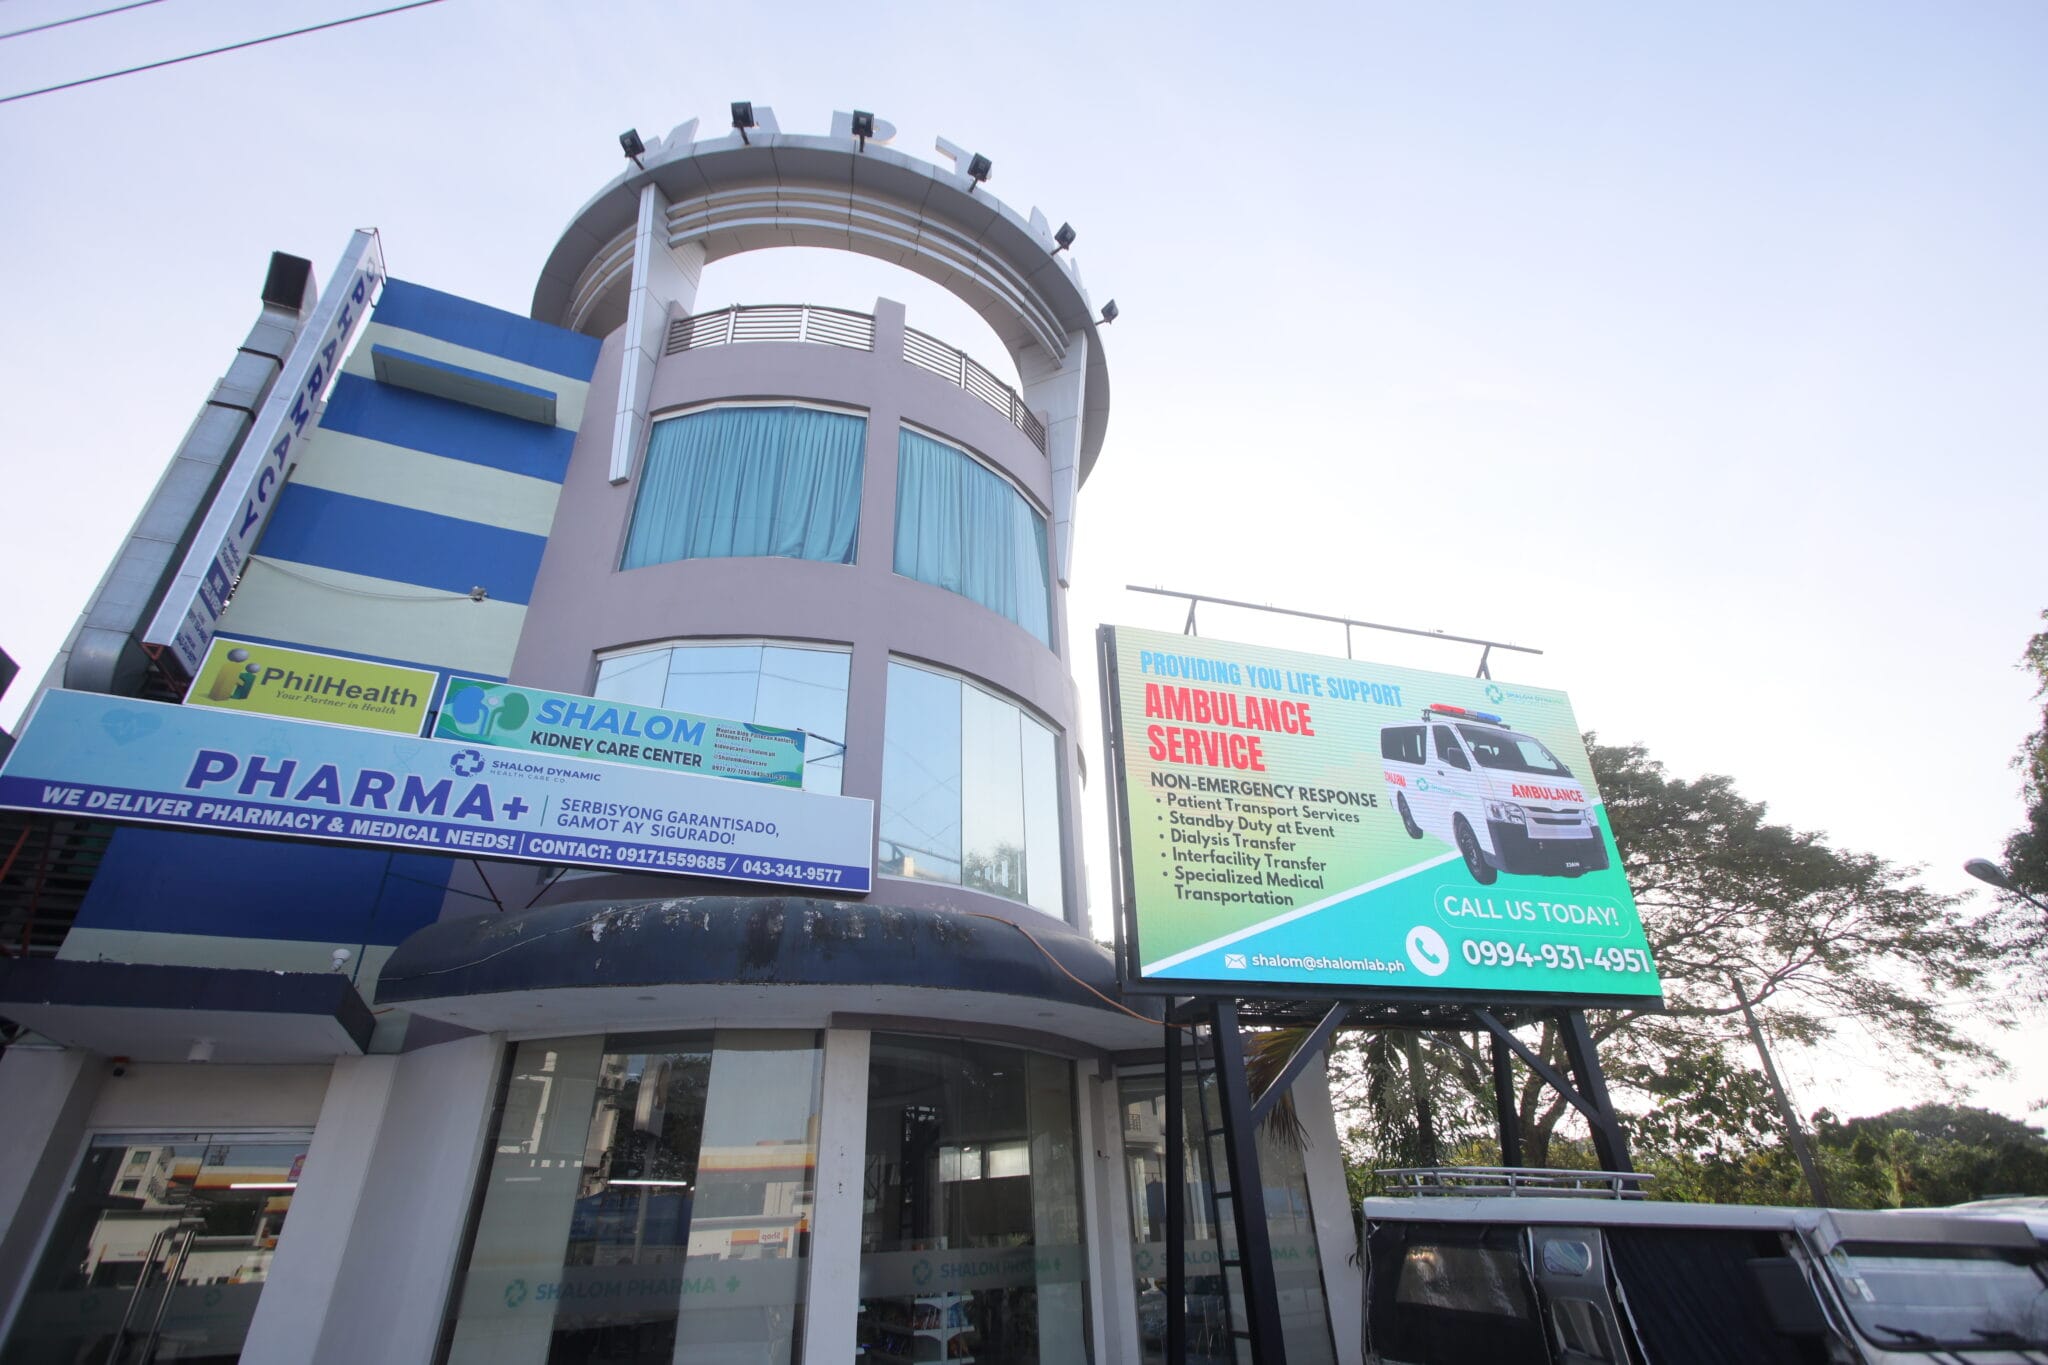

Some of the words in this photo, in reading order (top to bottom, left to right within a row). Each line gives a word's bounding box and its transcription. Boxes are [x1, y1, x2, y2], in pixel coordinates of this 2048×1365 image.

[239, 275, 366, 538] PHARMACY
[260, 667, 418, 708] PhilHealth
[1140, 650, 1242, 687] PROVIDING
[1245, 666, 1282, 692] YOU
[1288, 671, 1324, 697] LIFE
[1327, 678, 1402, 707] SUPPORT
[276, 690, 301, 702] Your
[303, 694, 346, 709] Partner
[348, 700, 359, 710] in
[361, 703, 397, 716] Health
[1145, 682, 1315, 737] AMBULANCE
[535, 699, 707, 746] SHALOM
[530, 730, 594, 753] KIDNEY
[595, 740, 639, 759] CARE
[641, 746, 703, 769] CENTER
[1147, 724, 1266, 772] SERVICE
[490, 769, 524, 778] HEALTH
[528, 774, 550, 782] CARE
[492, 760, 544, 774] SHALOM
[547, 767, 602, 782] DYNAMIC
[1151, 771, 1296, 800] NON-EMERGENCY
[1299, 786, 1378, 808] RESPONSE
[1511, 784, 1585, 803] AMBULANCE
[560, 798, 664, 823] SERBISYONG
[667, 808, 780, 839] GARANTISADO,
[1167, 792, 1222, 811] Patient
[1225, 798, 1298, 819] Transport
[1302, 807, 1360, 824] Services
[42, 785, 84, 806] WE
[88, 789, 192, 818] DELIVER
[196, 802, 323, 831] PHARMACY
[327, 815, 344, 832] &
[349, 818, 441, 843] MEDICAL
[445, 829, 515, 851] NEEDS!
[529, 838, 612, 860] CONTACT:
[616, 846, 726, 871] 09171559685
[742, 859, 842, 884] 043-341-9577
[556, 813, 619, 833] GAMOT
[621, 820, 643, 835] AY
[650, 823, 736, 846] SIGURADO!
[1169, 811, 1233, 832] Standby
[1238, 816, 1272, 836] Duty
[1277, 823, 1292, 834] at
[1295, 821, 1335, 838] Event
[1170, 828, 1230, 848] Dialysis
[1233, 833, 1296, 852] Transfer
[1173, 846, 1261, 870] Interfacility
[1264, 853, 1326, 872] Transfer
[1175, 866, 1263, 887] Specialized
[1267, 872, 1324, 890] Medical
[1175, 884, 1294, 907] Transportation
[1444, 896, 1503, 919] CALL
[1505, 901, 1536, 921] US
[1538, 902, 1620, 927] TODAY!
[1252, 954, 1406, 974] shalom@shalomlab.ph
[1462, 939, 1651, 974] 0994-931-4951
[940, 1261, 999, 1278] SHALOM
[536, 1279, 622, 1300] SHALOM
[627, 1276, 716, 1297] PHARMA
